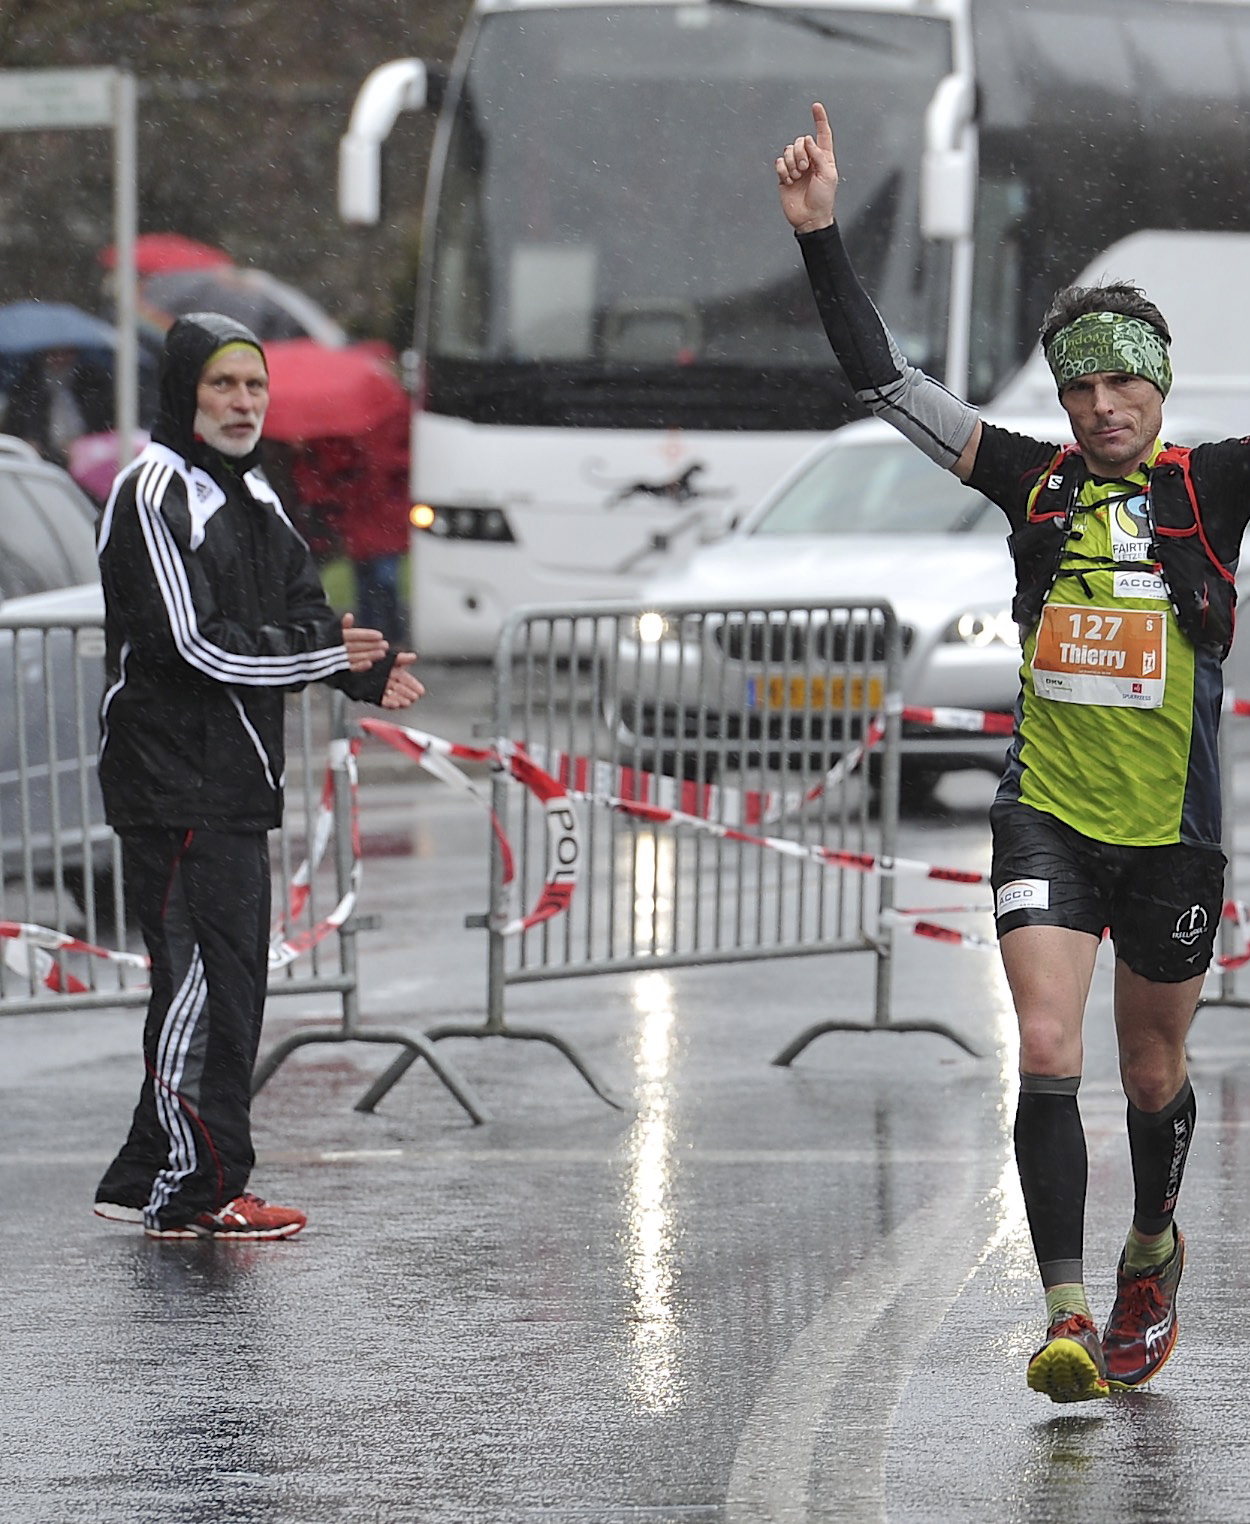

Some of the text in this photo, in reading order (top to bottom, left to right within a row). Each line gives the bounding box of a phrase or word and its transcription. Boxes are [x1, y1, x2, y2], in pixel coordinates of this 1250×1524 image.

[1120, 579, 1162, 589] ACCO
[1069, 613, 1123, 641] 127
[1145, 619, 1154, 631] S
[1060, 642, 1127, 670] Thierry
[999, 889, 1033, 905] ACCO
